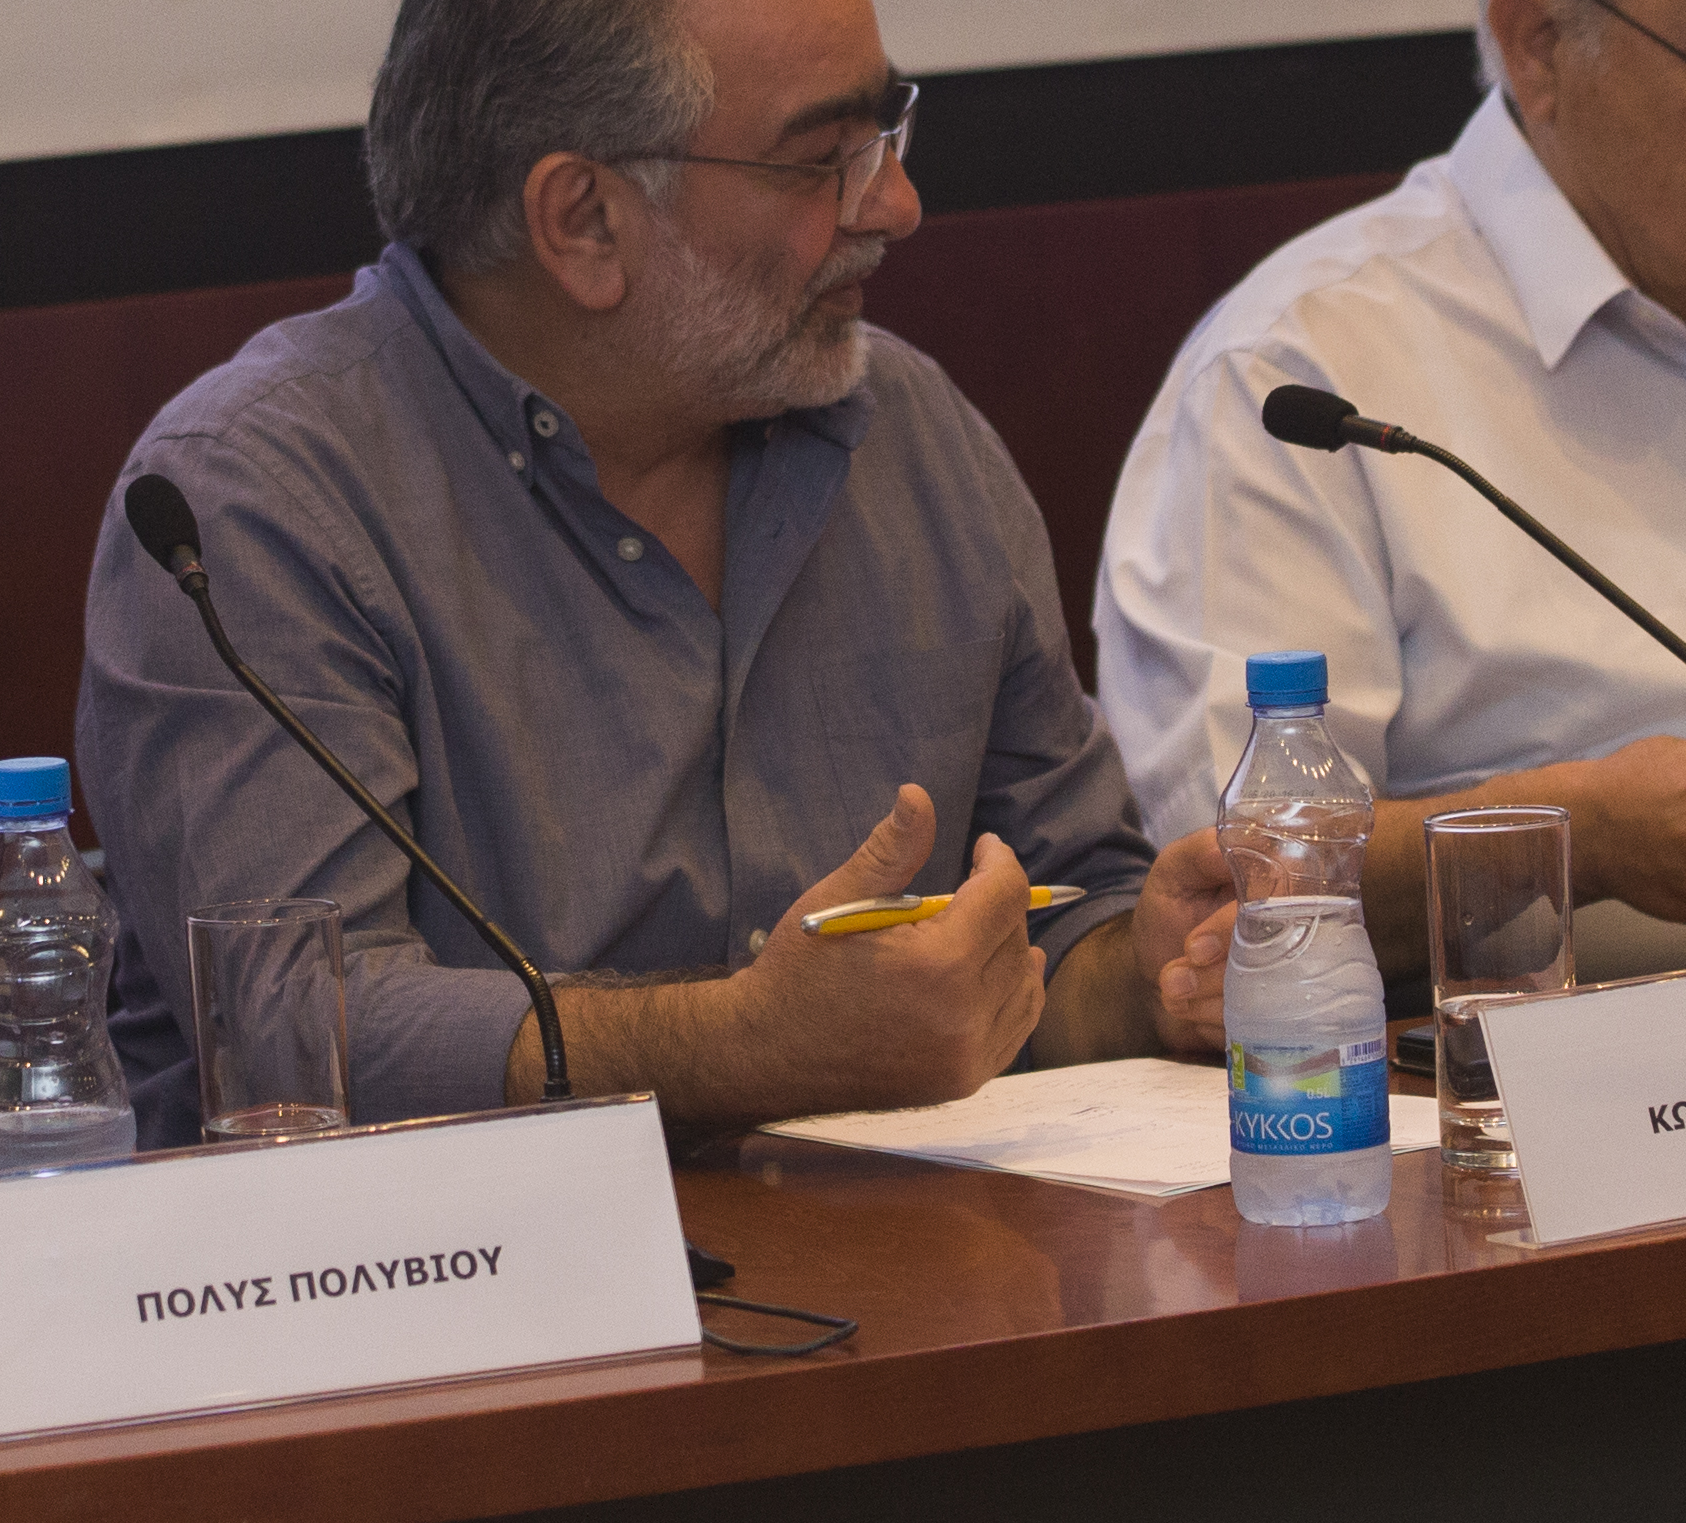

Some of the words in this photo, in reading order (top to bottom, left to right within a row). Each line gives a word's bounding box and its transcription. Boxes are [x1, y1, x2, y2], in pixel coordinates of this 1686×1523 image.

[1233, 1110, 1334, 1141] KYKKOS
[135, 1276, 278, 1324] ΠΟΛΥΣ
[288, 1244, 503, 1304] ΠΟΛΥΒΙΟΥ
